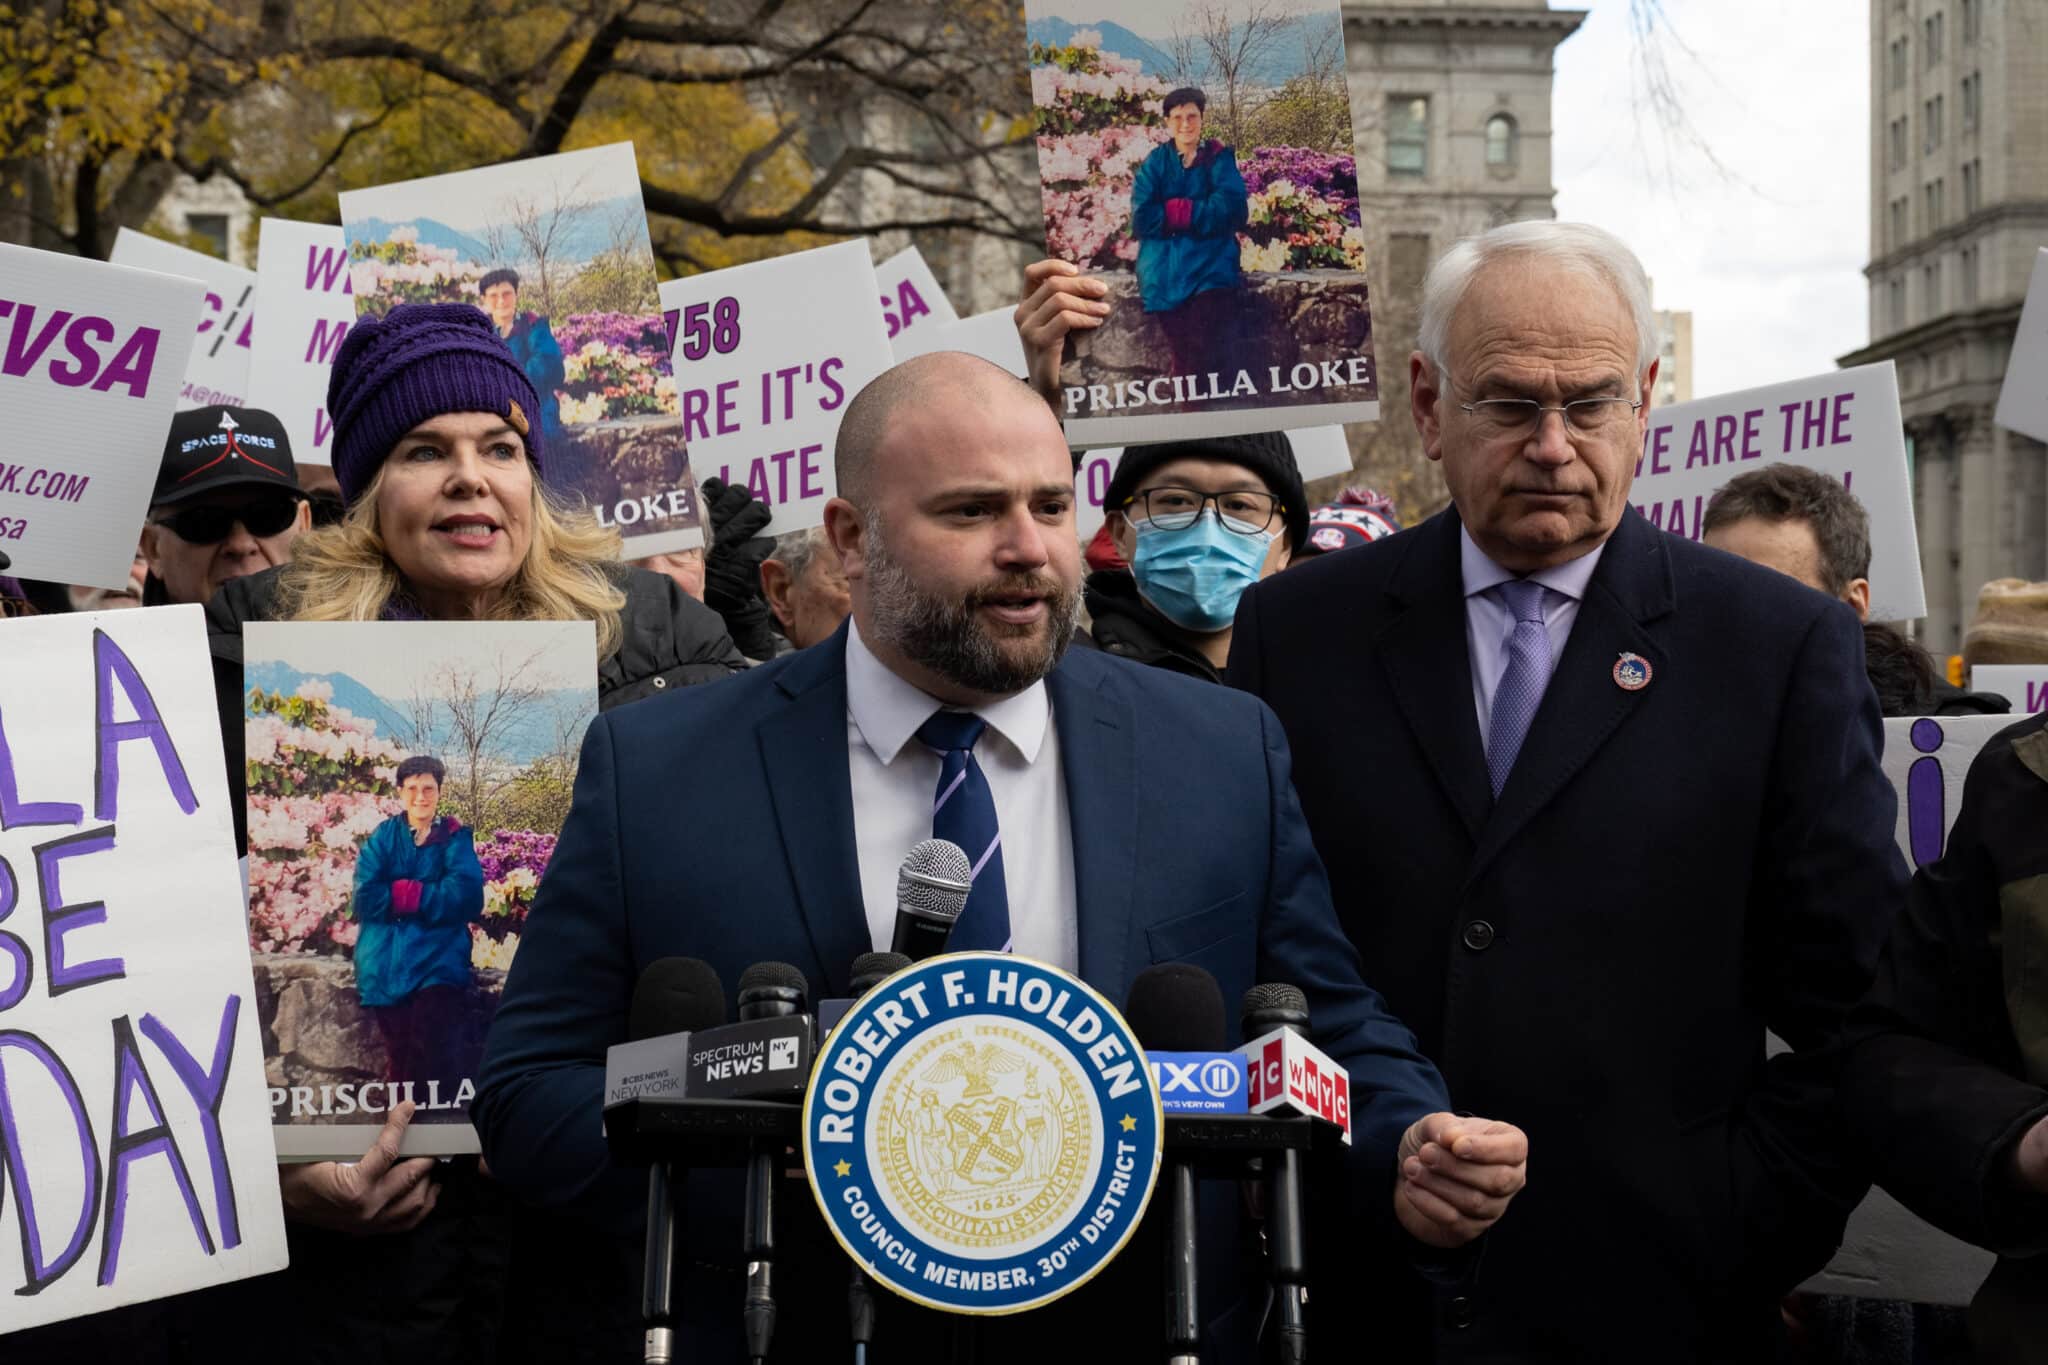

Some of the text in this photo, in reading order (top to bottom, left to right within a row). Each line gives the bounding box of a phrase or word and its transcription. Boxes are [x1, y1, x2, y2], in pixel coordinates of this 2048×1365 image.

[761, 357, 845, 426] IT'S
[1065, 357, 1370, 414] PRISCILLA LOKE
[181, 433, 276, 453] SPACE FORCE
[1686, 409, 1765, 470] ARE
[1779, 392, 1855, 453] THE
[594, 488, 690, 528] LOKE
[692, 1041, 765, 1067] SPECTRUM
[772, 1041, 789, 1051] NY
[786, 1051, 795, 1065] 1
[819, 969, 1142, 1143] ROBERT F. HOLDEN
[645, 1069, 669, 1081] NEWS
[706, 1055, 764, 1082] NEWS
[270, 1078, 477, 1118] PRISCILLA
[611, 1077, 680, 1102] NEW YORK
[1289, 1059, 1347, 1118] WNYC
[1181, 1101, 1203, 1109] VERY
[843, 1140, 1137, 1292] COUNCIL MEMBER, 30TH DISTRICT
[931, 1206, 1027, 1236] CIVITATIS
